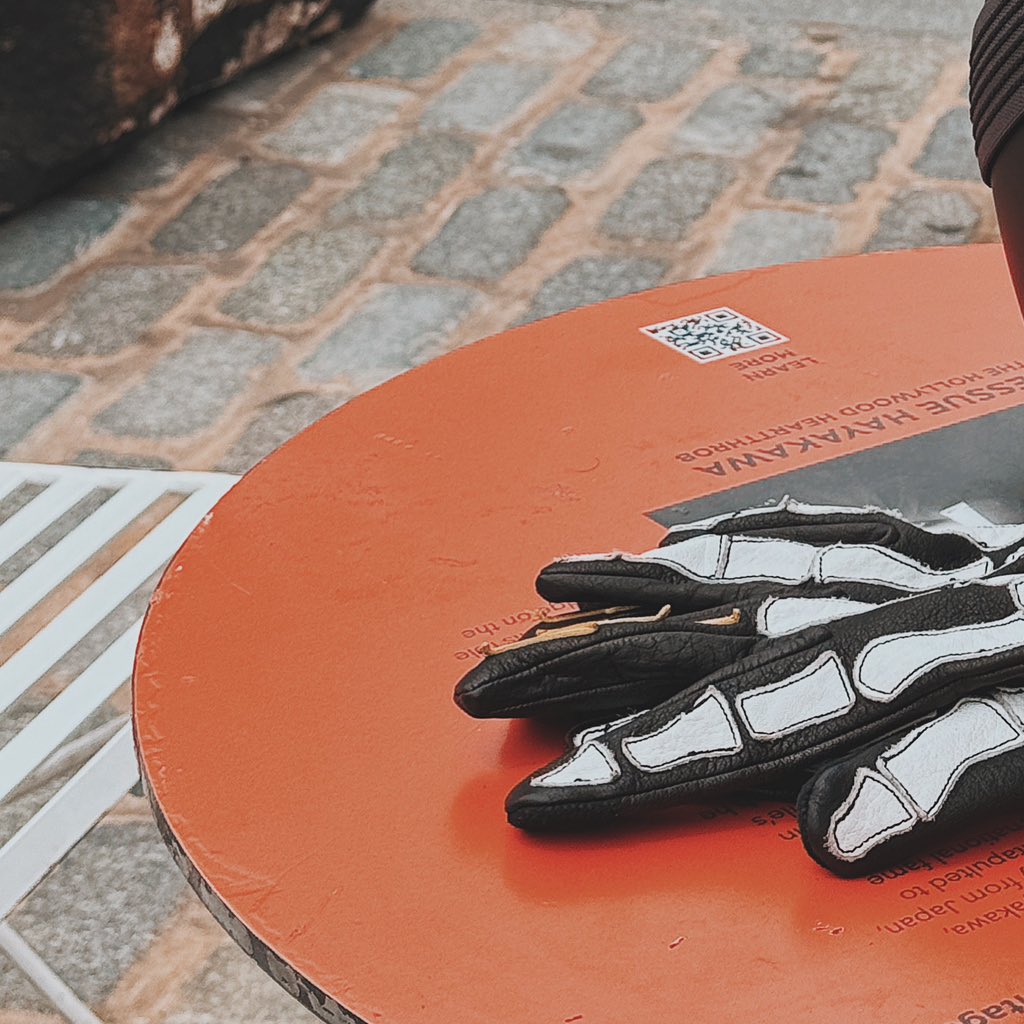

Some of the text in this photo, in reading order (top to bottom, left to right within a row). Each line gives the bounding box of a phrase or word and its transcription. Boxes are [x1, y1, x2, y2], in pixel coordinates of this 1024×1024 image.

[728, 349, 795, 372] MORE
[744, 357, 819, 383] LEARN
[840, 376, 977, 418] HOLLYWOOD
[675, 412, 843, 463] HEARTTHROB
[693, 406, 918, 477] HAYAKAWA
[461, 623, 498, 640] the
[866, 856, 933, 886] fame
[899, 886, 930, 901] to
[960, 875, 1024, 904] from
[876, 899, 960, 935] Japan,
